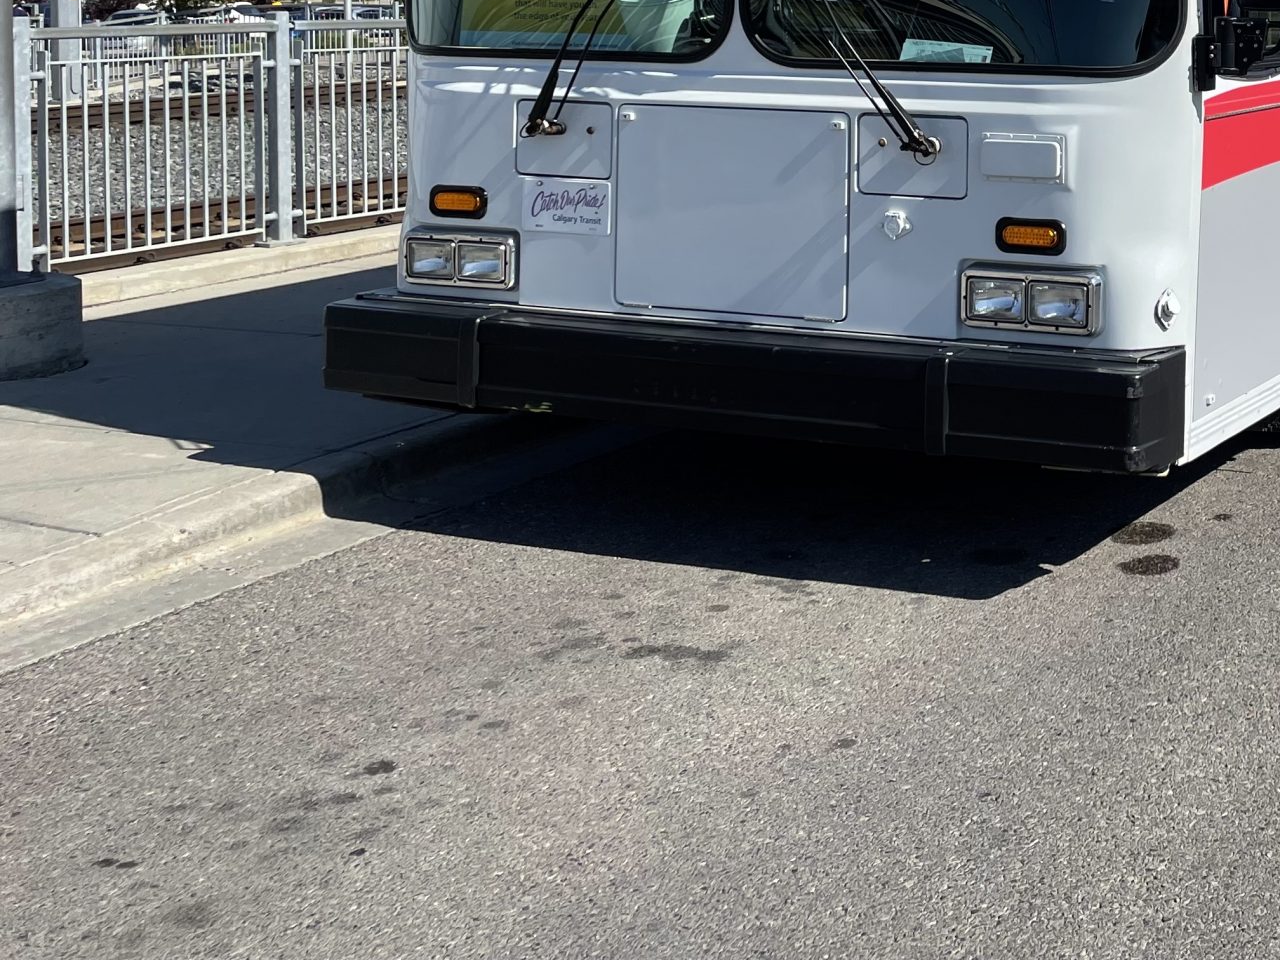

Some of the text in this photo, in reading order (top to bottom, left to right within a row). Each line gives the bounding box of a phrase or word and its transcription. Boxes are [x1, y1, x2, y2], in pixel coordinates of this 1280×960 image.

[531, 191, 559, 217] Catch
[560, 189, 576, 210] Our
[552, 214, 602, 225] Calgary Transit
